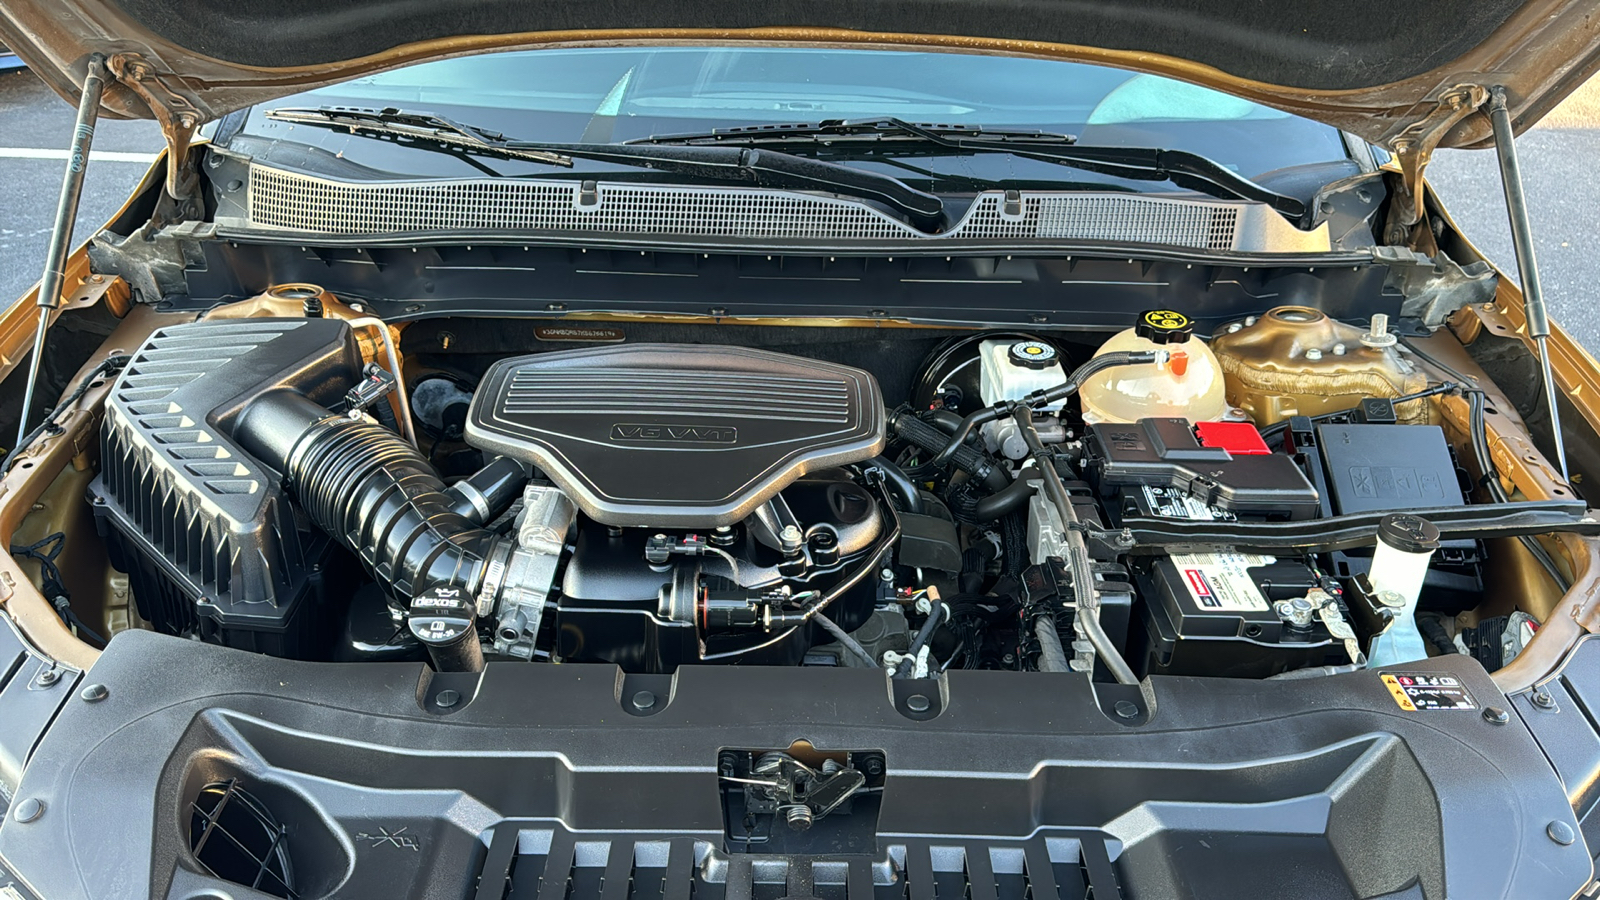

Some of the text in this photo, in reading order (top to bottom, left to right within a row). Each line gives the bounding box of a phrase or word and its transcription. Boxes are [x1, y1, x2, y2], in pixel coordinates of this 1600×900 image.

[617, 426, 733, 440] V6 VVT
[415, 596, 460, 607] dexos
